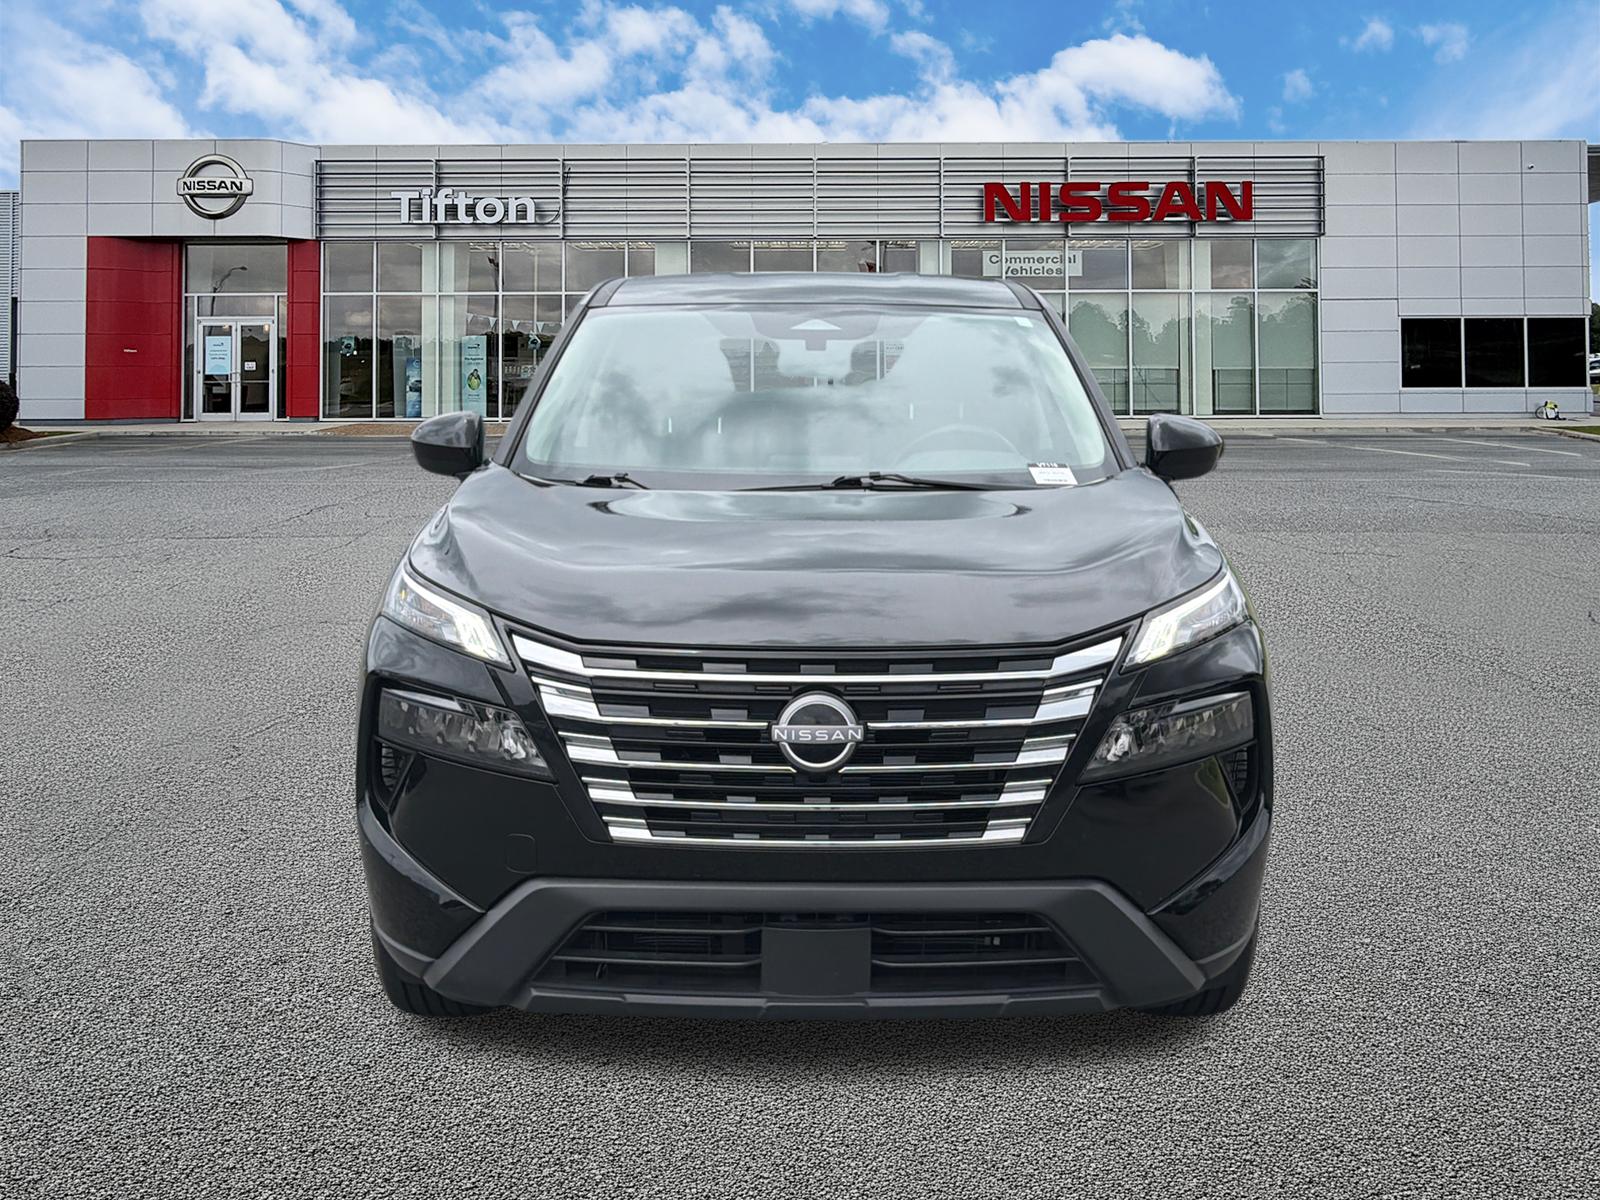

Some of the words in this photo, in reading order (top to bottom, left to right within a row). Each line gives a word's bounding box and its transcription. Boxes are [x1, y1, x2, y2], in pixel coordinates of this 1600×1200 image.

[183, 181, 243, 191] NISSAN
[391, 188, 536, 224] Tifton
[983, 181, 1253, 222] NISSAN
[774, 729, 861, 740] NISSAN
